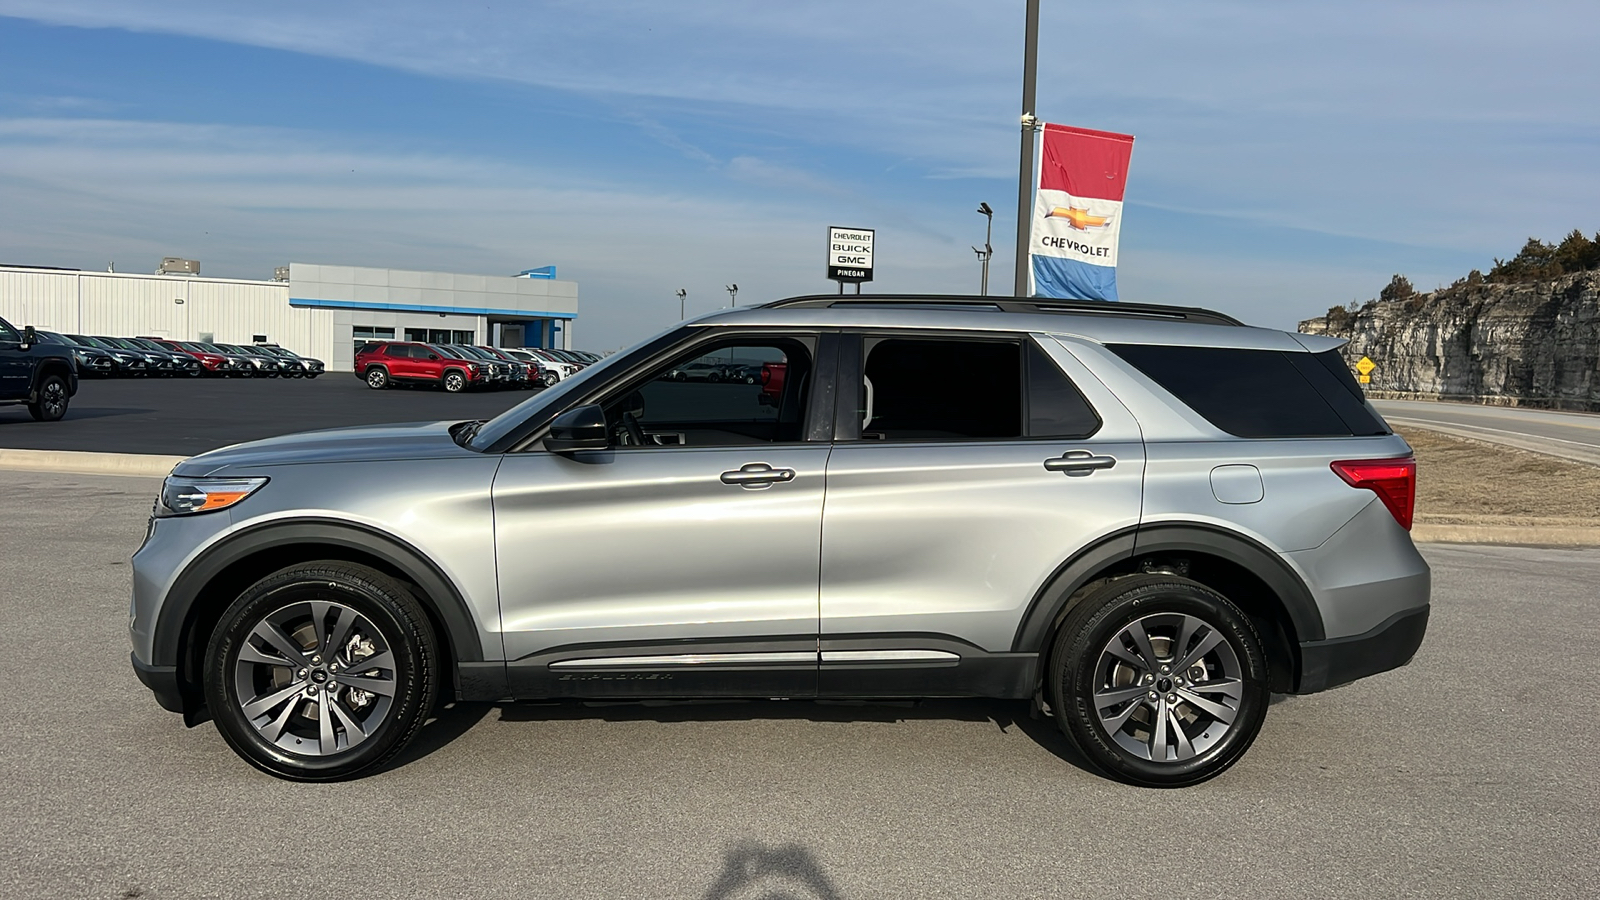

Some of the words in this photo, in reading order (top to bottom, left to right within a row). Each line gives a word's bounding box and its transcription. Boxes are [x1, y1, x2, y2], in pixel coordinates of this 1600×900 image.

[833, 232, 871, 242] CHEVROLET
[832, 243, 871, 254] BUICK
[1041, 236, 1110, 258] CHEVROLET
[837, 255, 866, 265] GMC
[837, 269, 865, 278] PINEGAR
